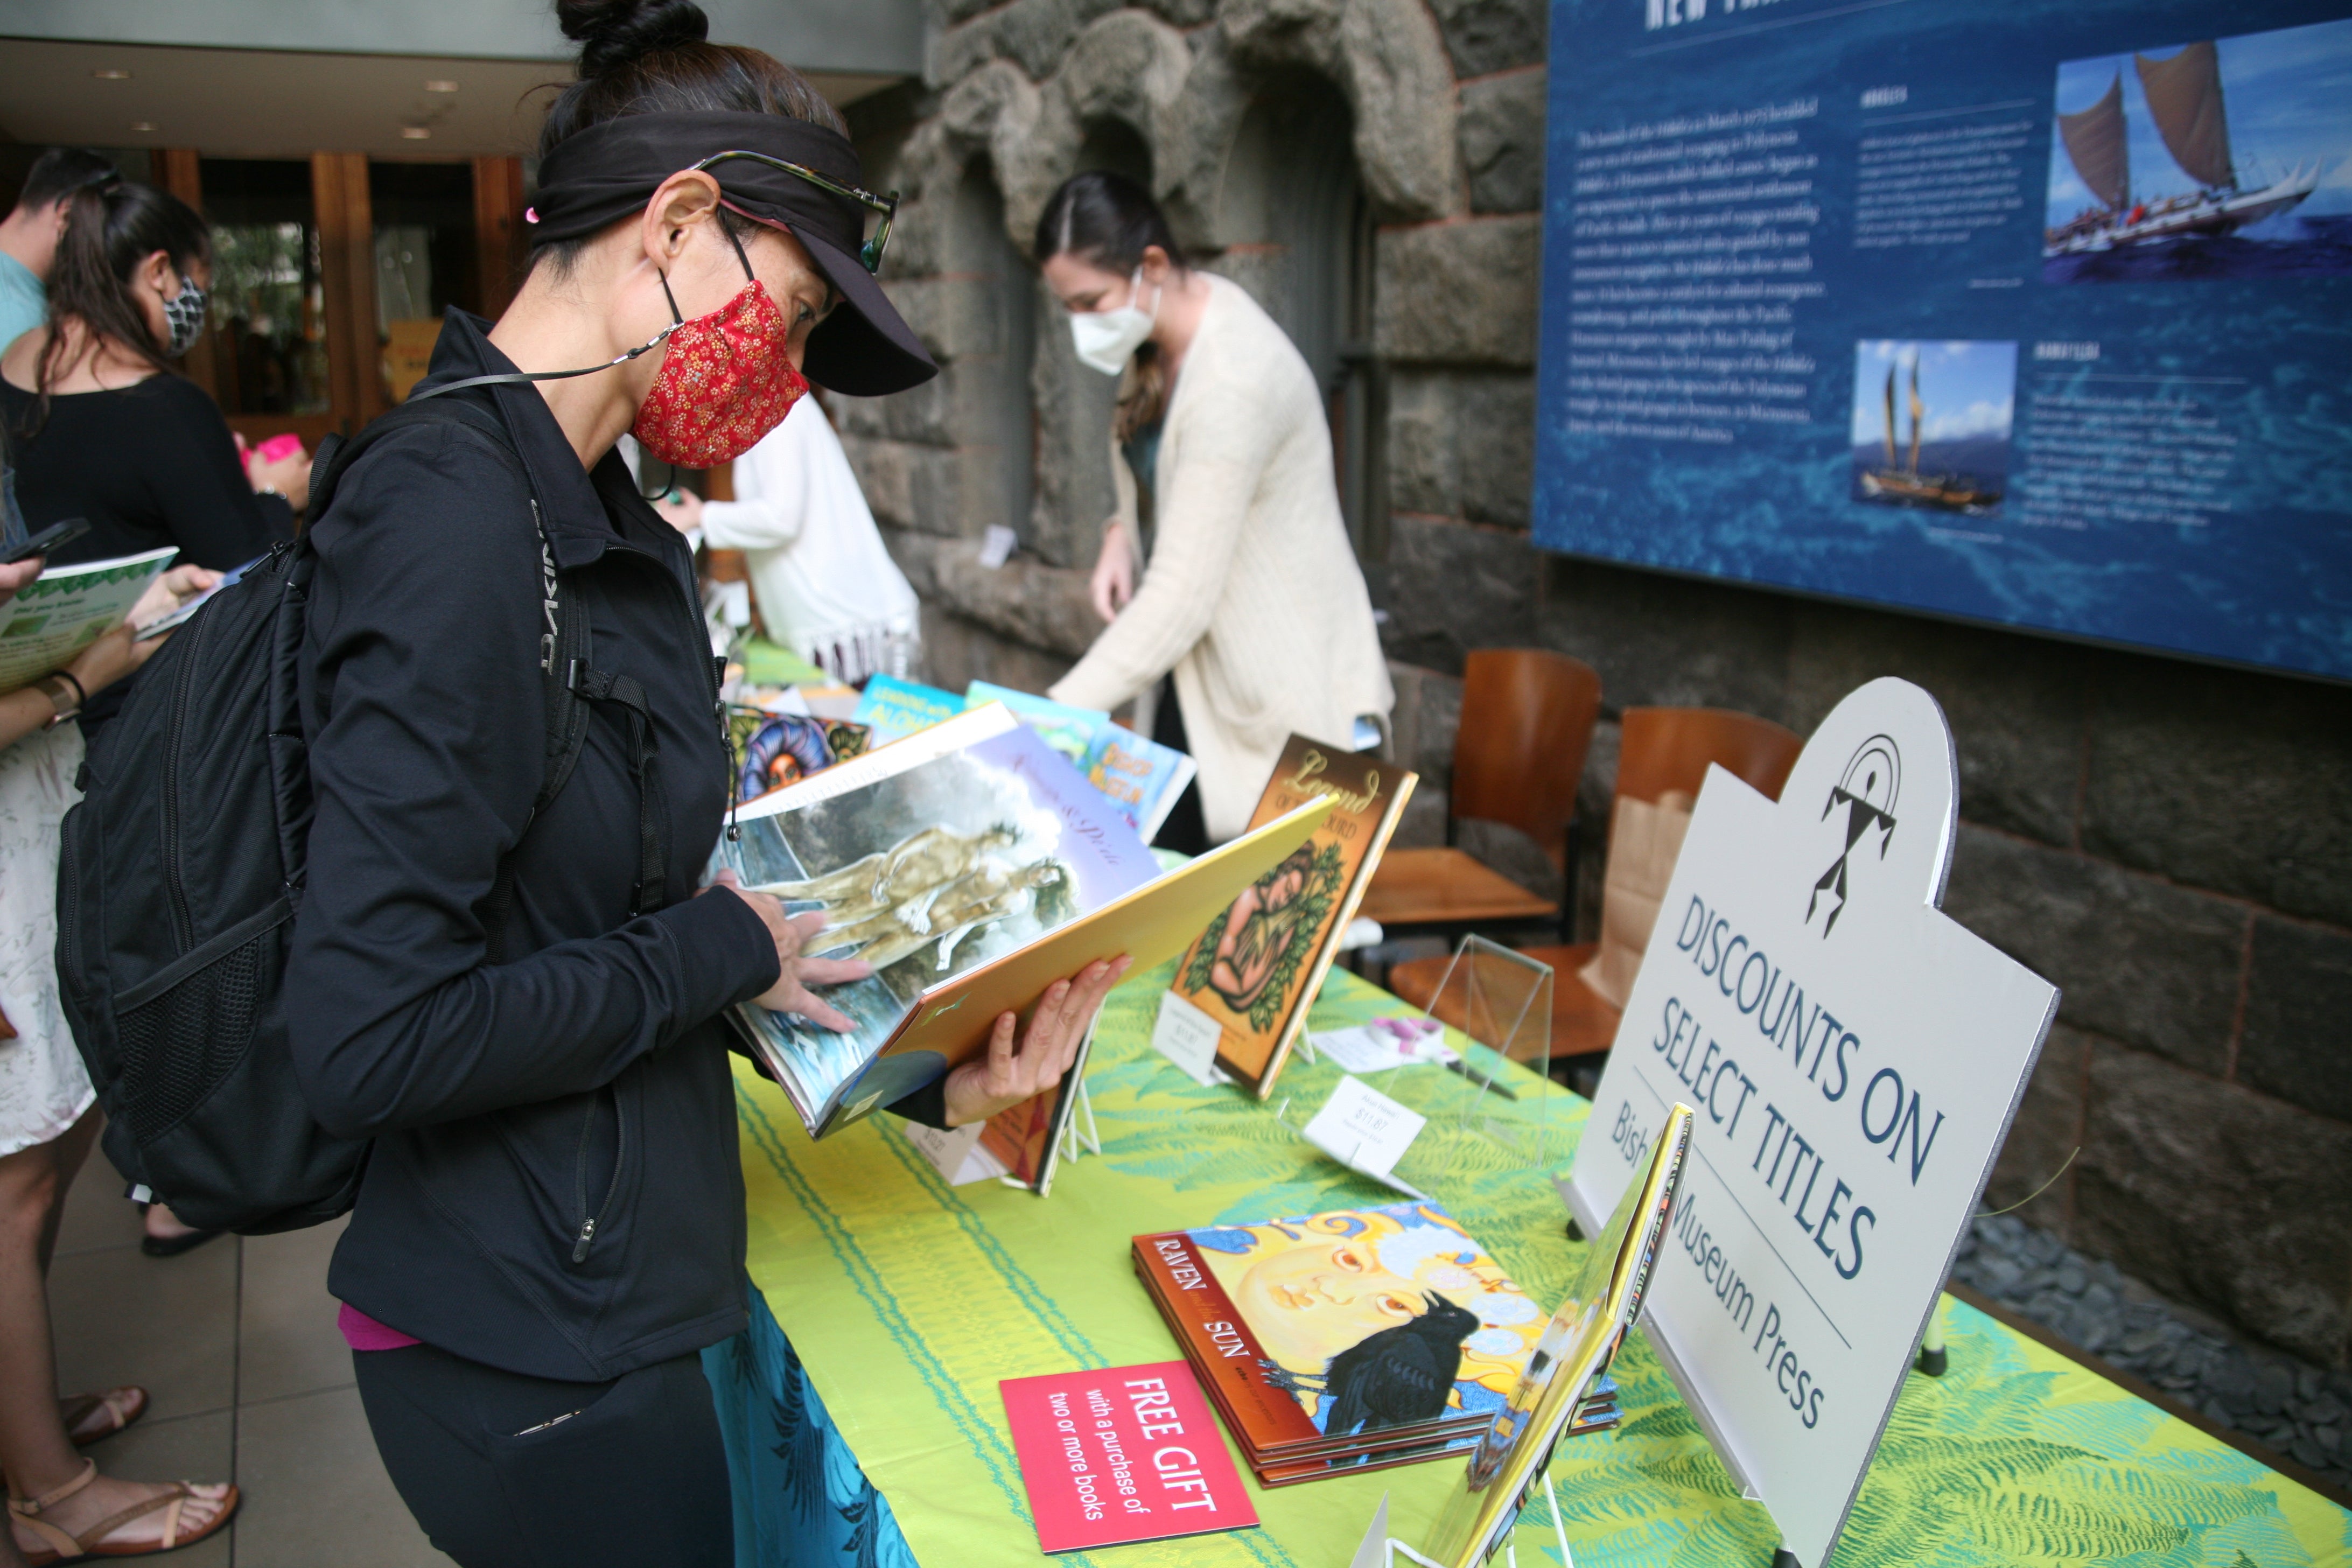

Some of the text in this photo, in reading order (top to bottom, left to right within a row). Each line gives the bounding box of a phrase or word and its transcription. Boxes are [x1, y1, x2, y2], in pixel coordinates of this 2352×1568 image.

[1322, 814, 1357, 840] OURD
[1676, 894, 1945, 1187] DISCOUNTS ON
[1654, 997, 1877, 1280] SELECT TITLES
[1154, 1238, 1208, 1291] RAVEN
[1203, 1320, 1251, 1359] SUN
[1612, 1100, 1824, 1429] Bish Museum Press
[1048, 1391, 1107, 1521] two or more books
[1086, 1389, 1151, 1514] with a purchase of
[1124, 1377, 1217, 1512] FREE GIFT
